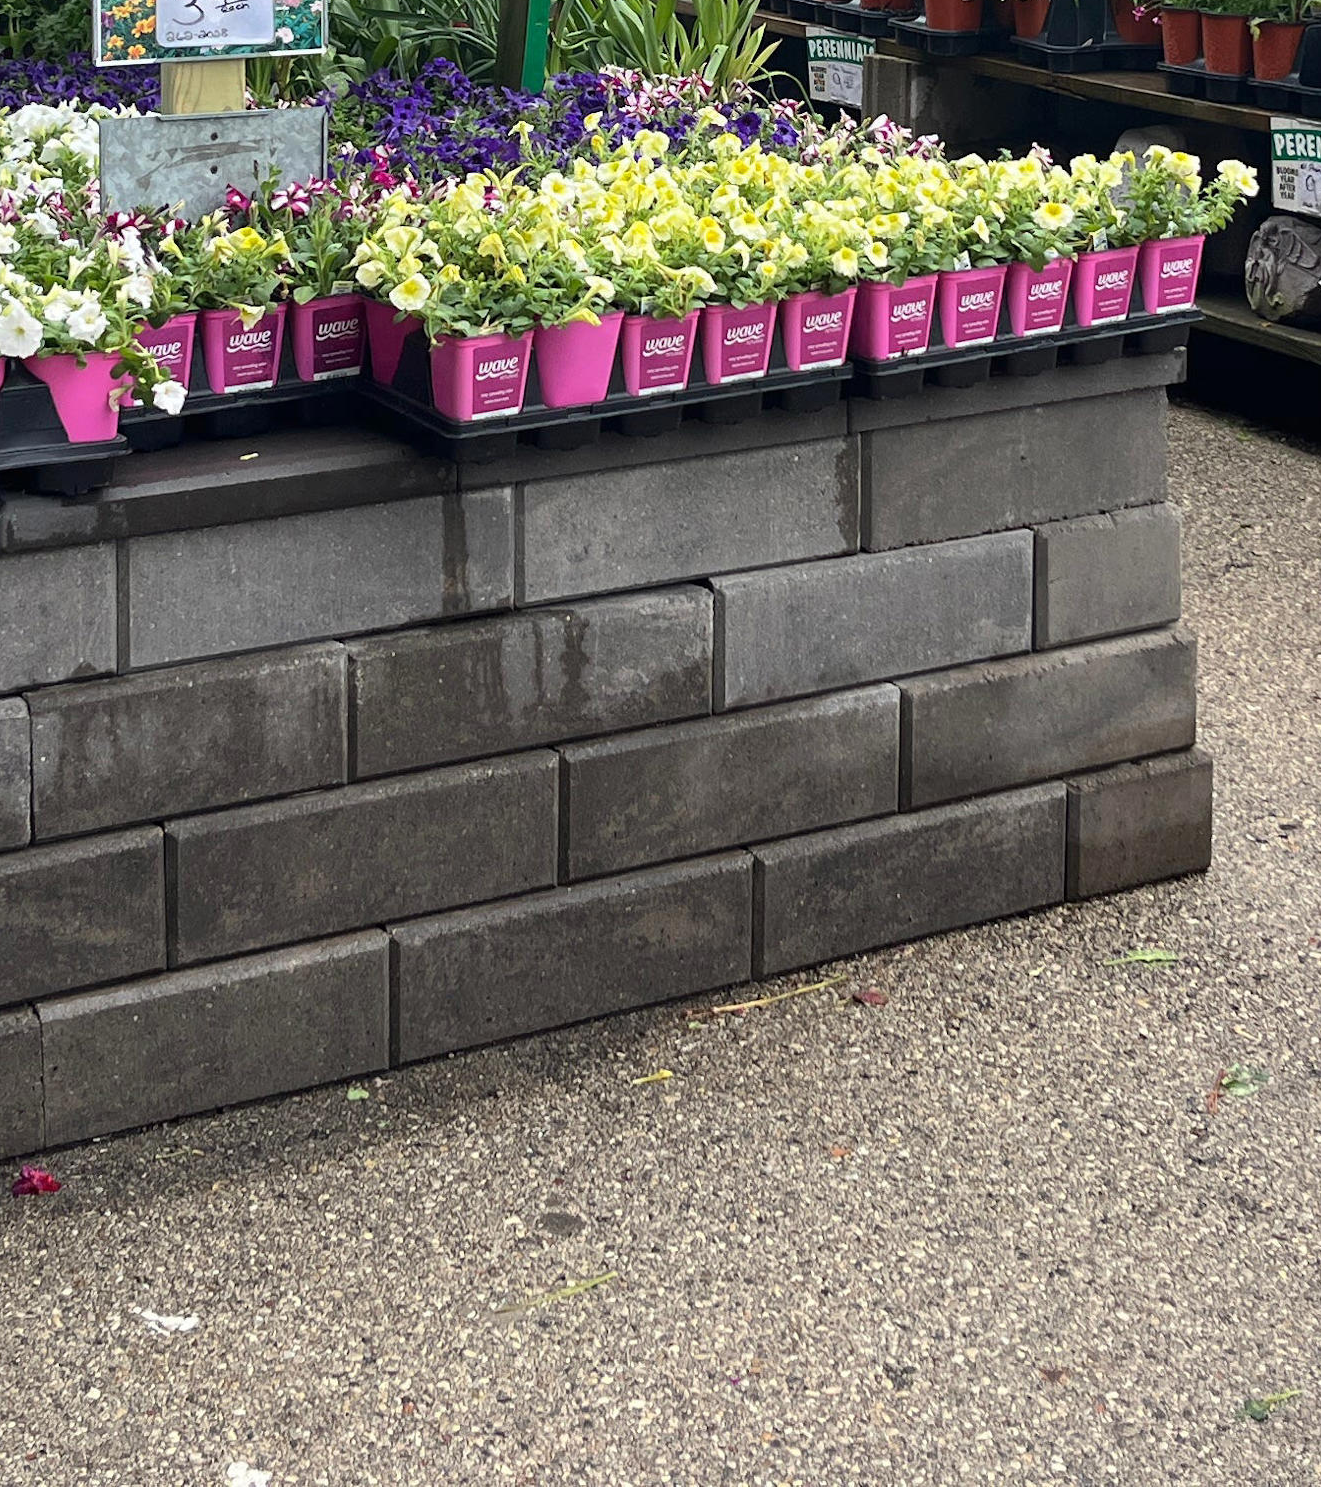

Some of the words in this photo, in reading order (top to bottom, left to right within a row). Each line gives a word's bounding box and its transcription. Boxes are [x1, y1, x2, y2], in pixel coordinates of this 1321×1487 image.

[1163, 258, 1194, 273] wave
[1098, 269, 1129, 286] wave
[1031, 279, 1063, 295] wave
[961, 290, 995, 306] wave
[893, 299, 927, 317] wave
[319, 318, 359, 335] wave
[806, 311, 843, 328] wave
[229, 330, 271, 347] wave
[726, 322, 764, 340] wave
[645, 334, 685, 350] wave
[478, 355, 519, 373] wave
